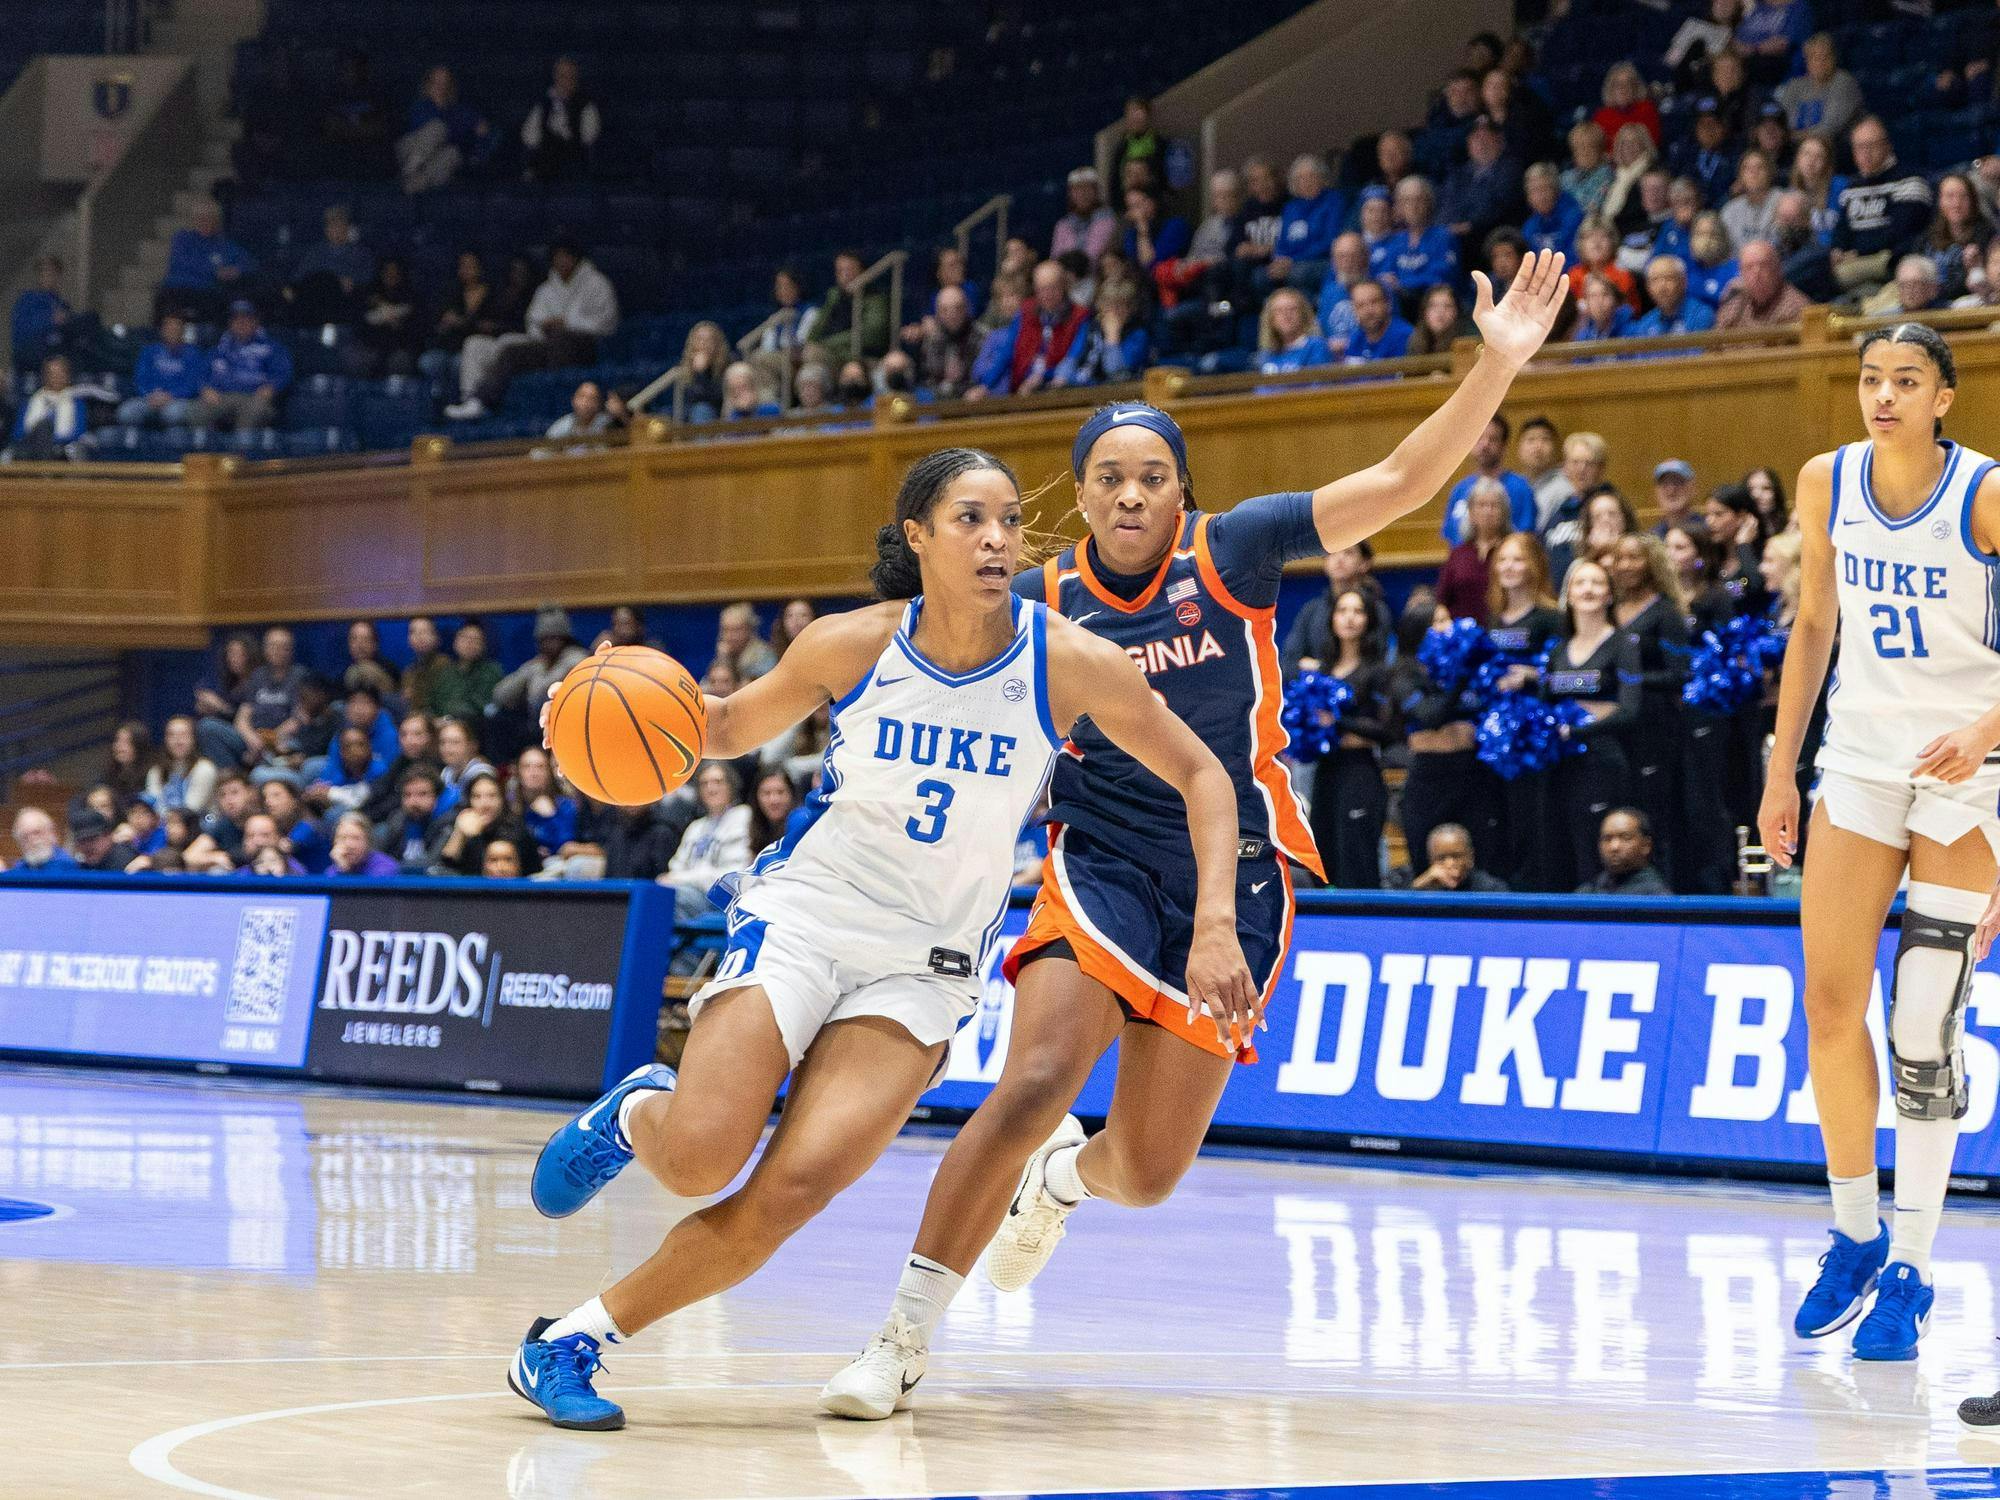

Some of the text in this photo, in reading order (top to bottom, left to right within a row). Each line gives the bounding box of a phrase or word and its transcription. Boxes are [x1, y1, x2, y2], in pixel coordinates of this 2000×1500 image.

[1844, 551, 1948, 599] DUKE
[1125, 629, 1226, 674] GINIA
[1869, 603, 1930, 658] 21
[874, 716, 1017, 777] DUKE
[905, 778, 956, 844] 3
[318, 929, 613, 1018] REEDS REEDS.com
[341, 1020, 442, 1048] JEWELERS
[1276, 951, 1660, 1114] DUKE
